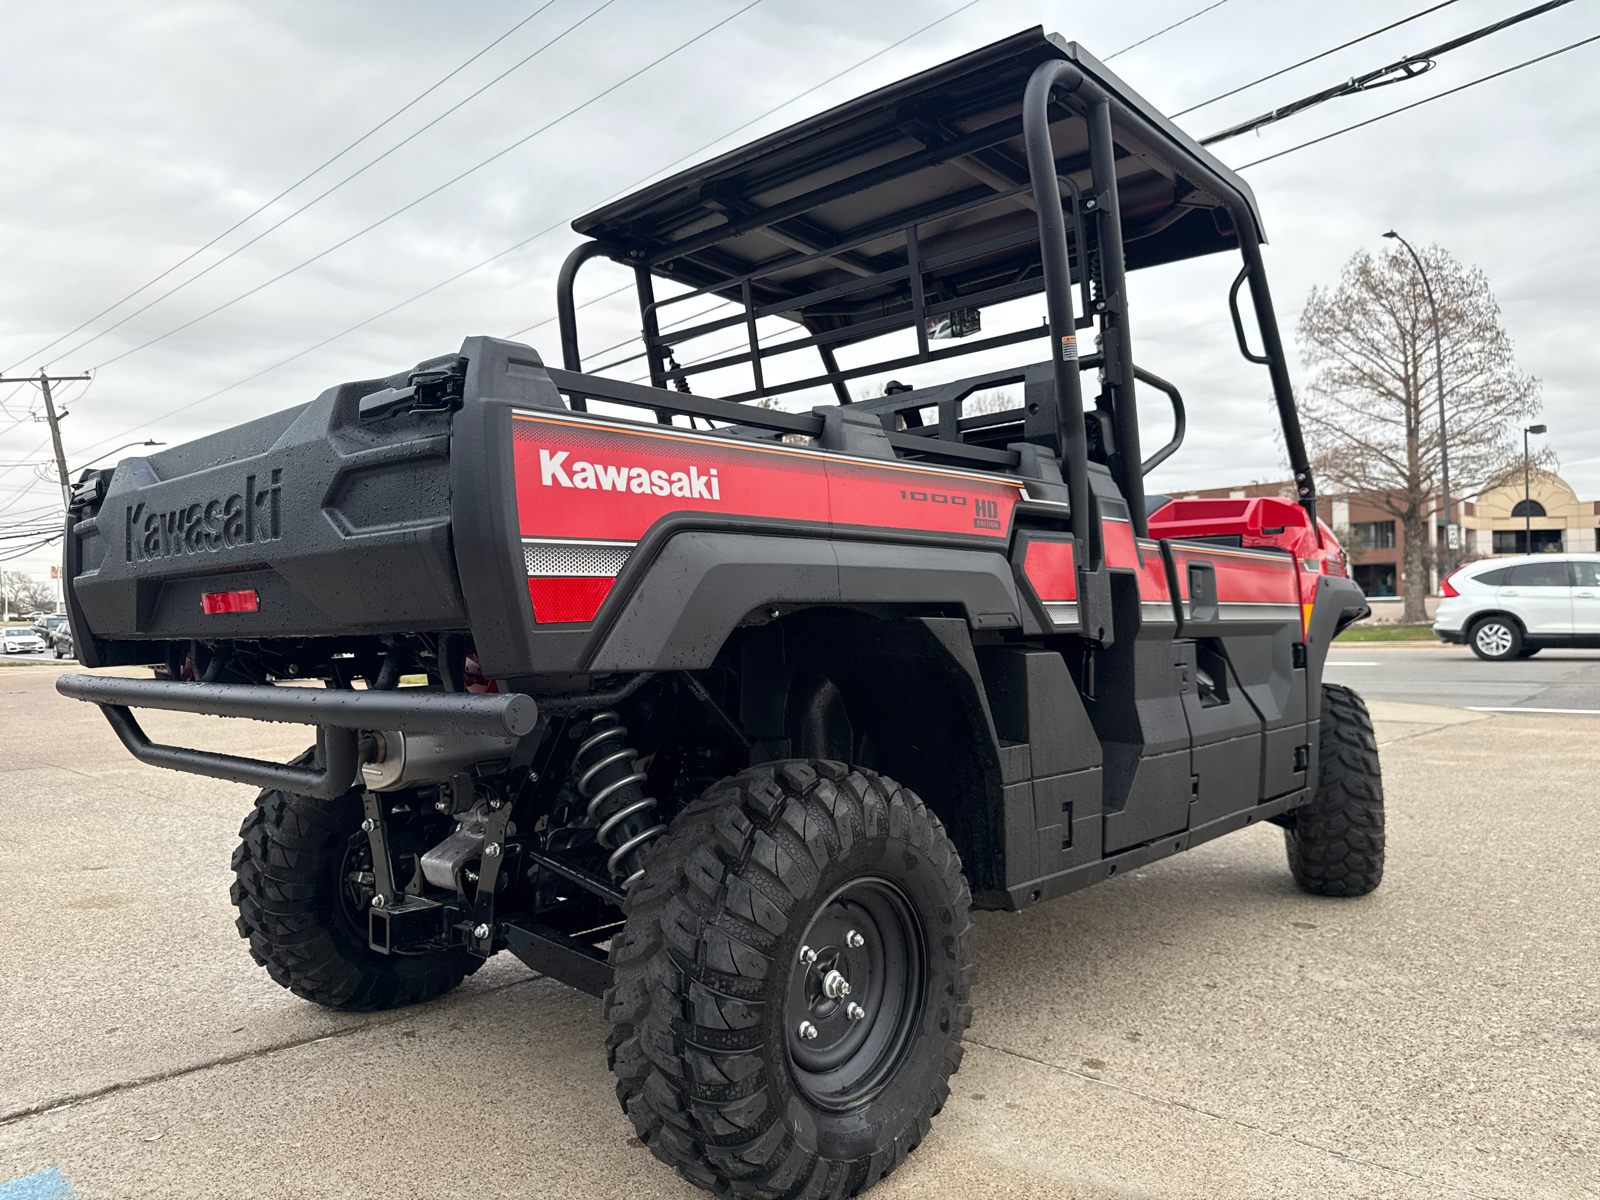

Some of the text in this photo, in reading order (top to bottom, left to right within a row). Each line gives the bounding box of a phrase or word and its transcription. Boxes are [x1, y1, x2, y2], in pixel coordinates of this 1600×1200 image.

[538, 448, 721, 501] Kawasaki
[125, 467, 283, 563] Kawasaki
[900, 490, 967, 506] 1000
[974, 498, 998, 519] HD
[976, 520, 999, 529] EDITION
[935, 904, 957, 1035] DURO
